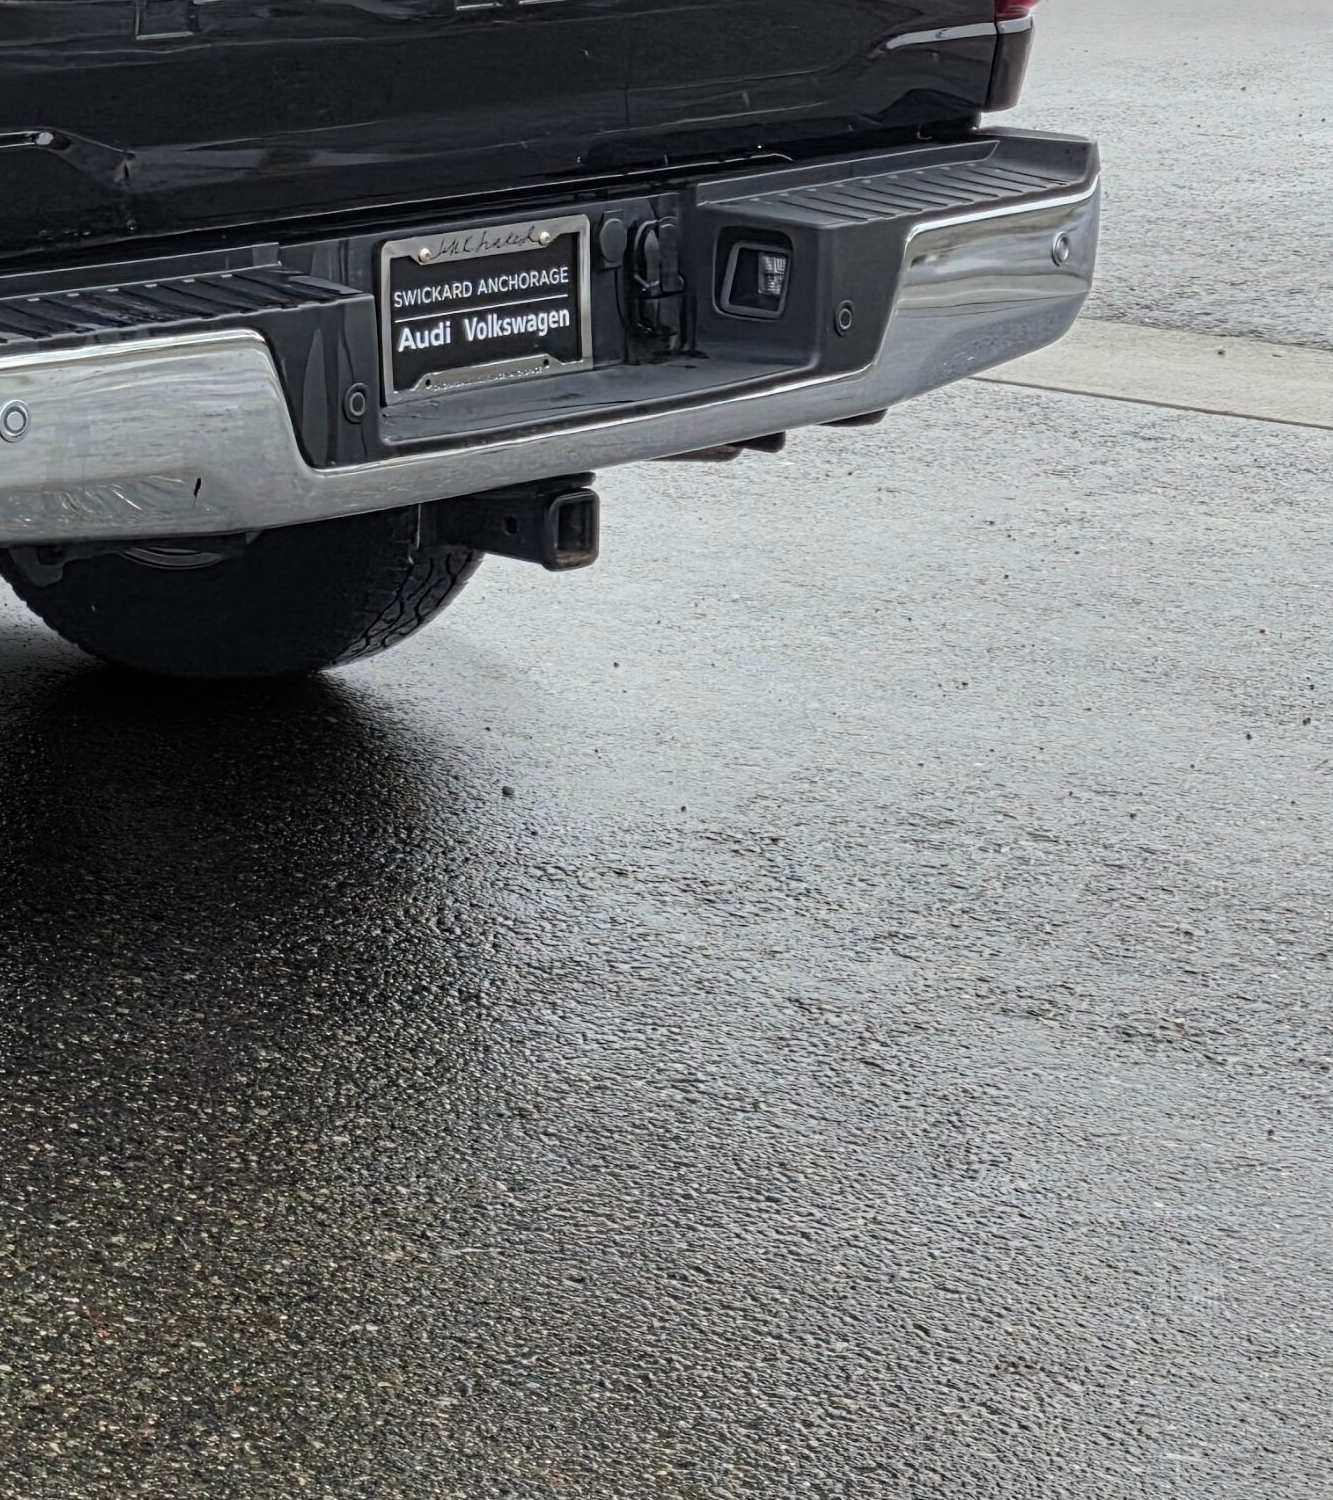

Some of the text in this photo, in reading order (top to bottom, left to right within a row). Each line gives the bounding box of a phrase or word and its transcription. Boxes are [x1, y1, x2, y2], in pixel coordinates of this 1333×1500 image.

[394, 267, 569, 308] SWICKARD ANCHORAGE
[398, 308, 570, 352] Audi Volkswagen
